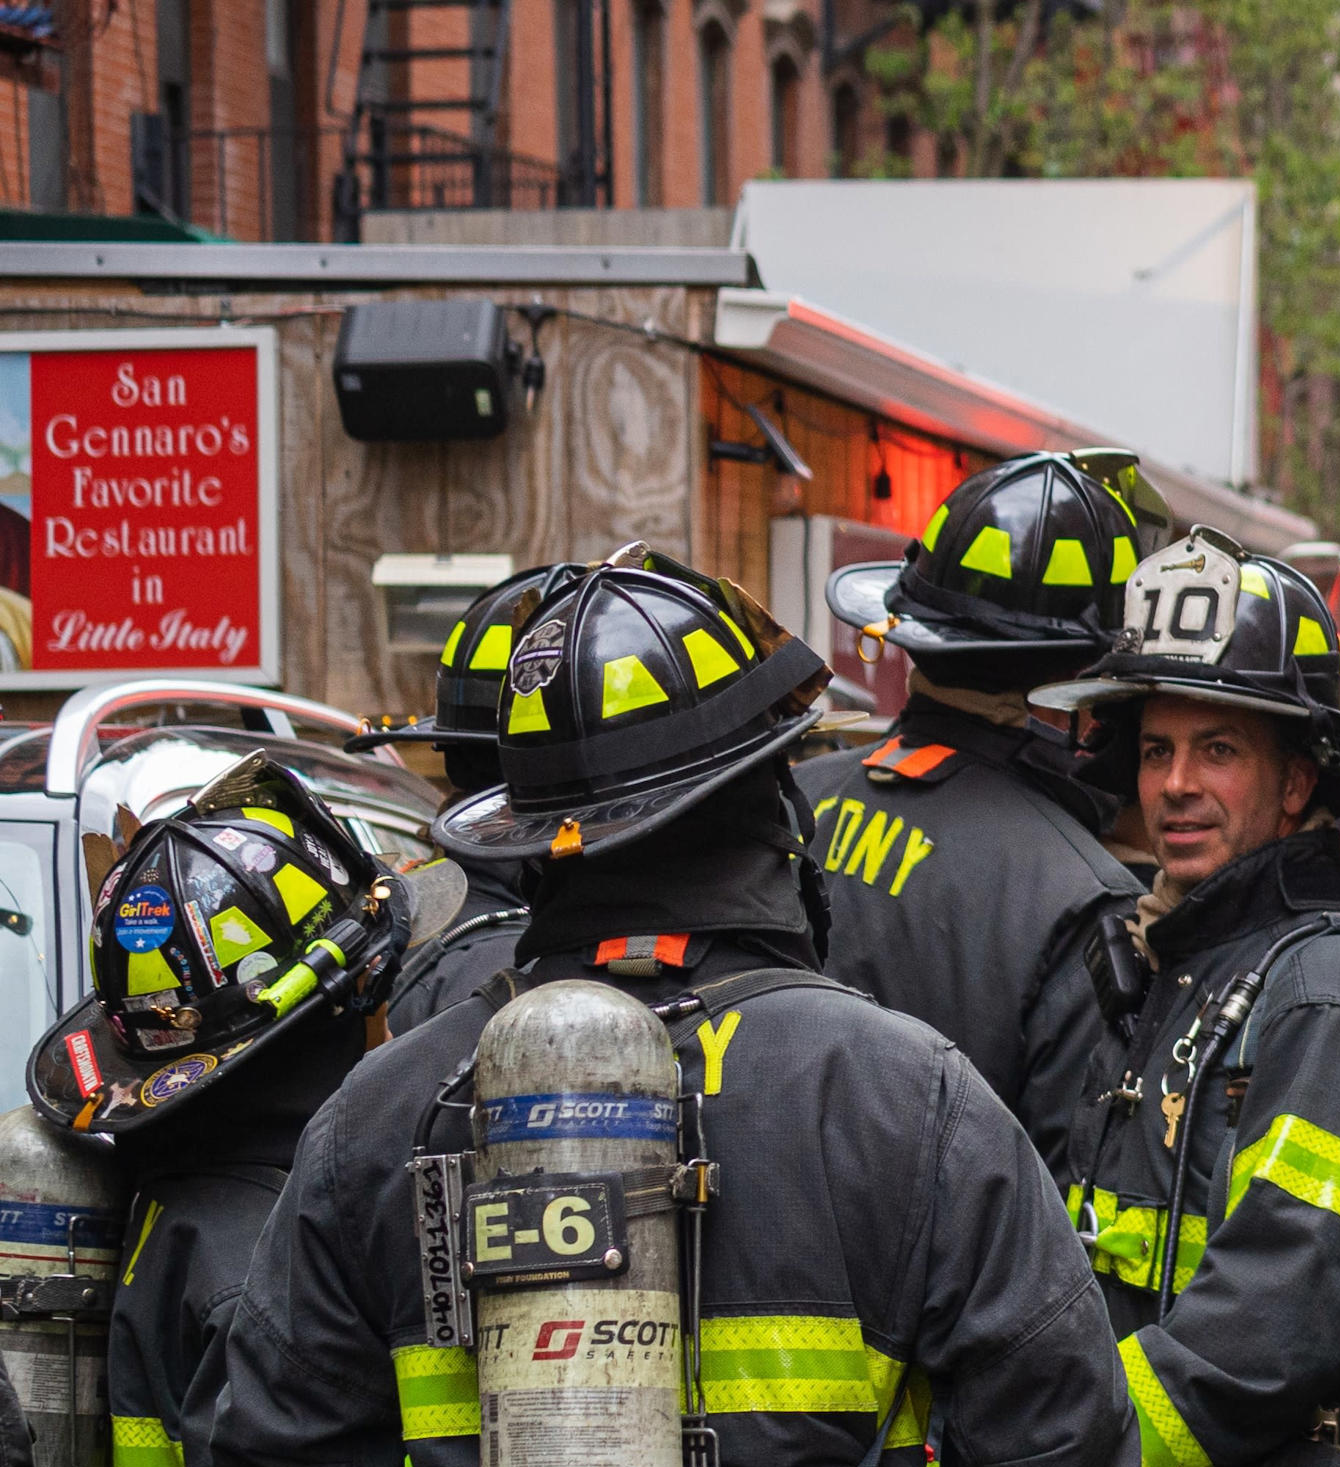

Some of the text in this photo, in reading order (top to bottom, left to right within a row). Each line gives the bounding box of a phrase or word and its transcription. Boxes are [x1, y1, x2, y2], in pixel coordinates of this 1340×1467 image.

[111, 362, 187, 407] San
[45, 413, 250, 458] Gennaro's
[72, 466, 223, 508] Favorite
[45, 516, 251, 557] Restaurant
[132, 565, 163, 604] in
[1143, 587, 1219, 641] 10
[47, 608, 247, 665] Little Italy
[120, 902, 171, 917] GirlTrek
[558, 1102, 628, 1118] SCOTT
[475, 1196, 596, 1263] E-6
[590, 1320, 679, 1349] SCOTT
